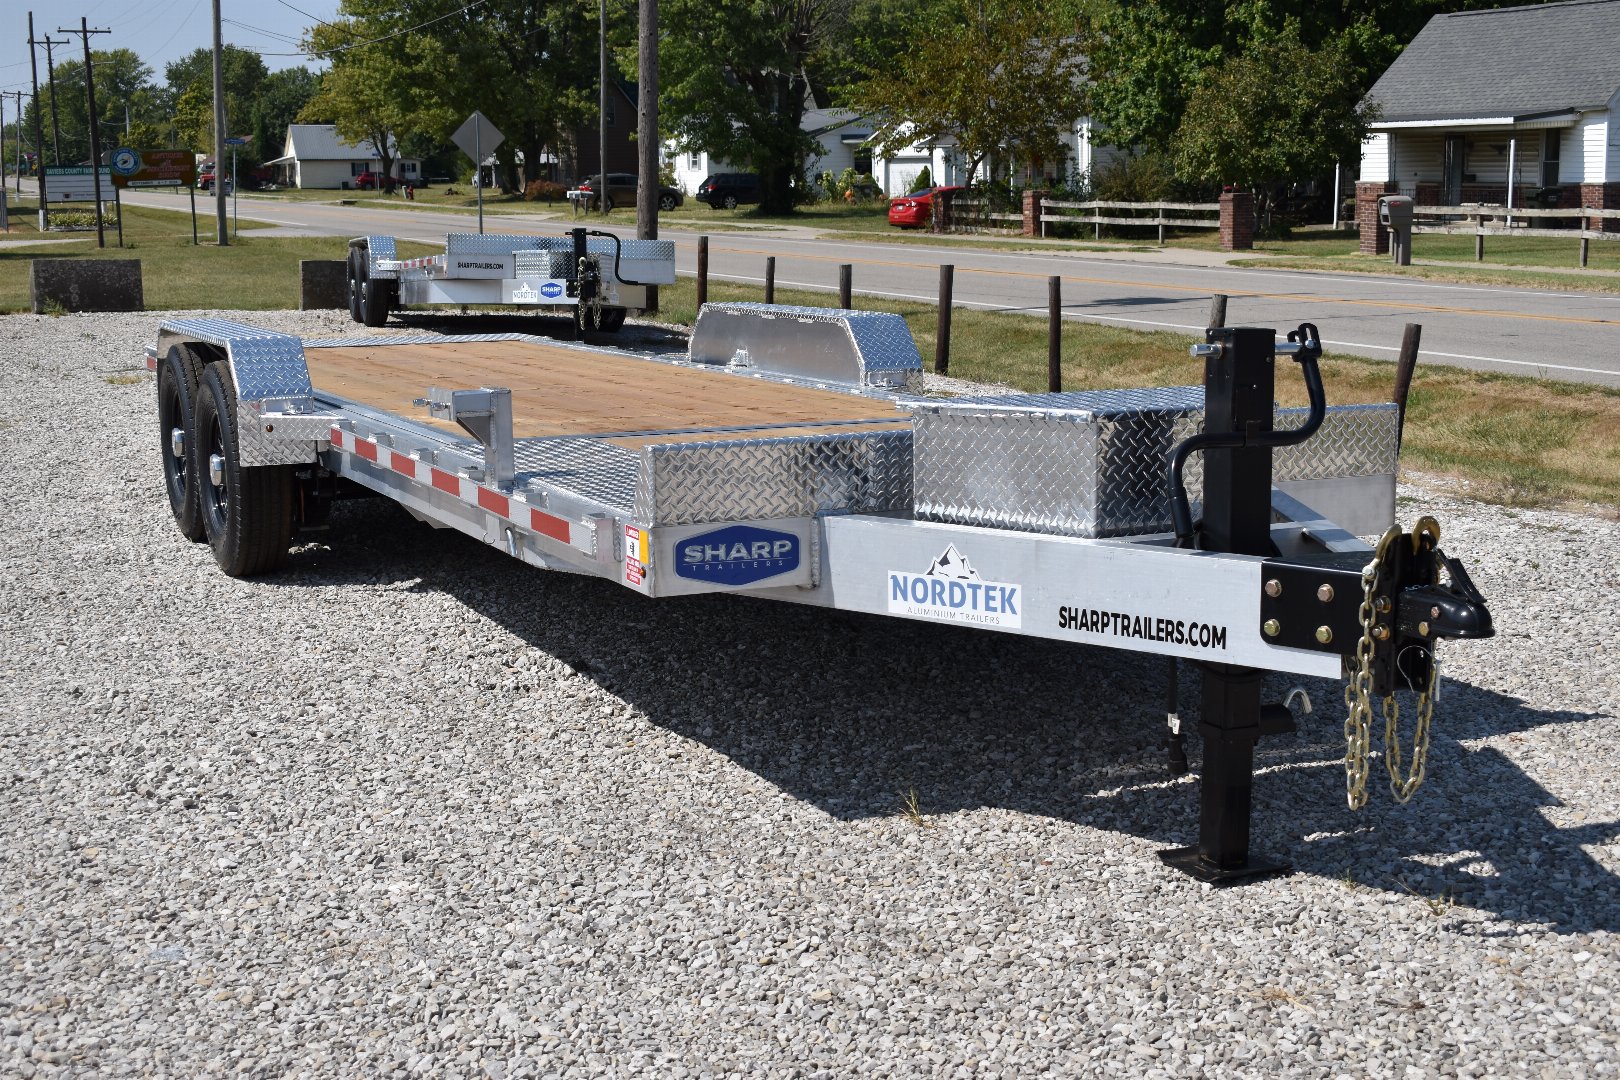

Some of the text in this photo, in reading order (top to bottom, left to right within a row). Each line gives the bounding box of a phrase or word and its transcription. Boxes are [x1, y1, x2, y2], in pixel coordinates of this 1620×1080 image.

[457, 261, 504, 270] SHARPTRAILERS.COM
[683, 540, 793, 563] SHARP
[692, 560, 783, 571] TRAILERS
[890, 574, 1018, 616] NORDTEK
[907, 606, 1001, 625] ALUMINIUM TRAILERS
[1058, 605, 1227, 650] SHARPTRAILERS.COM
